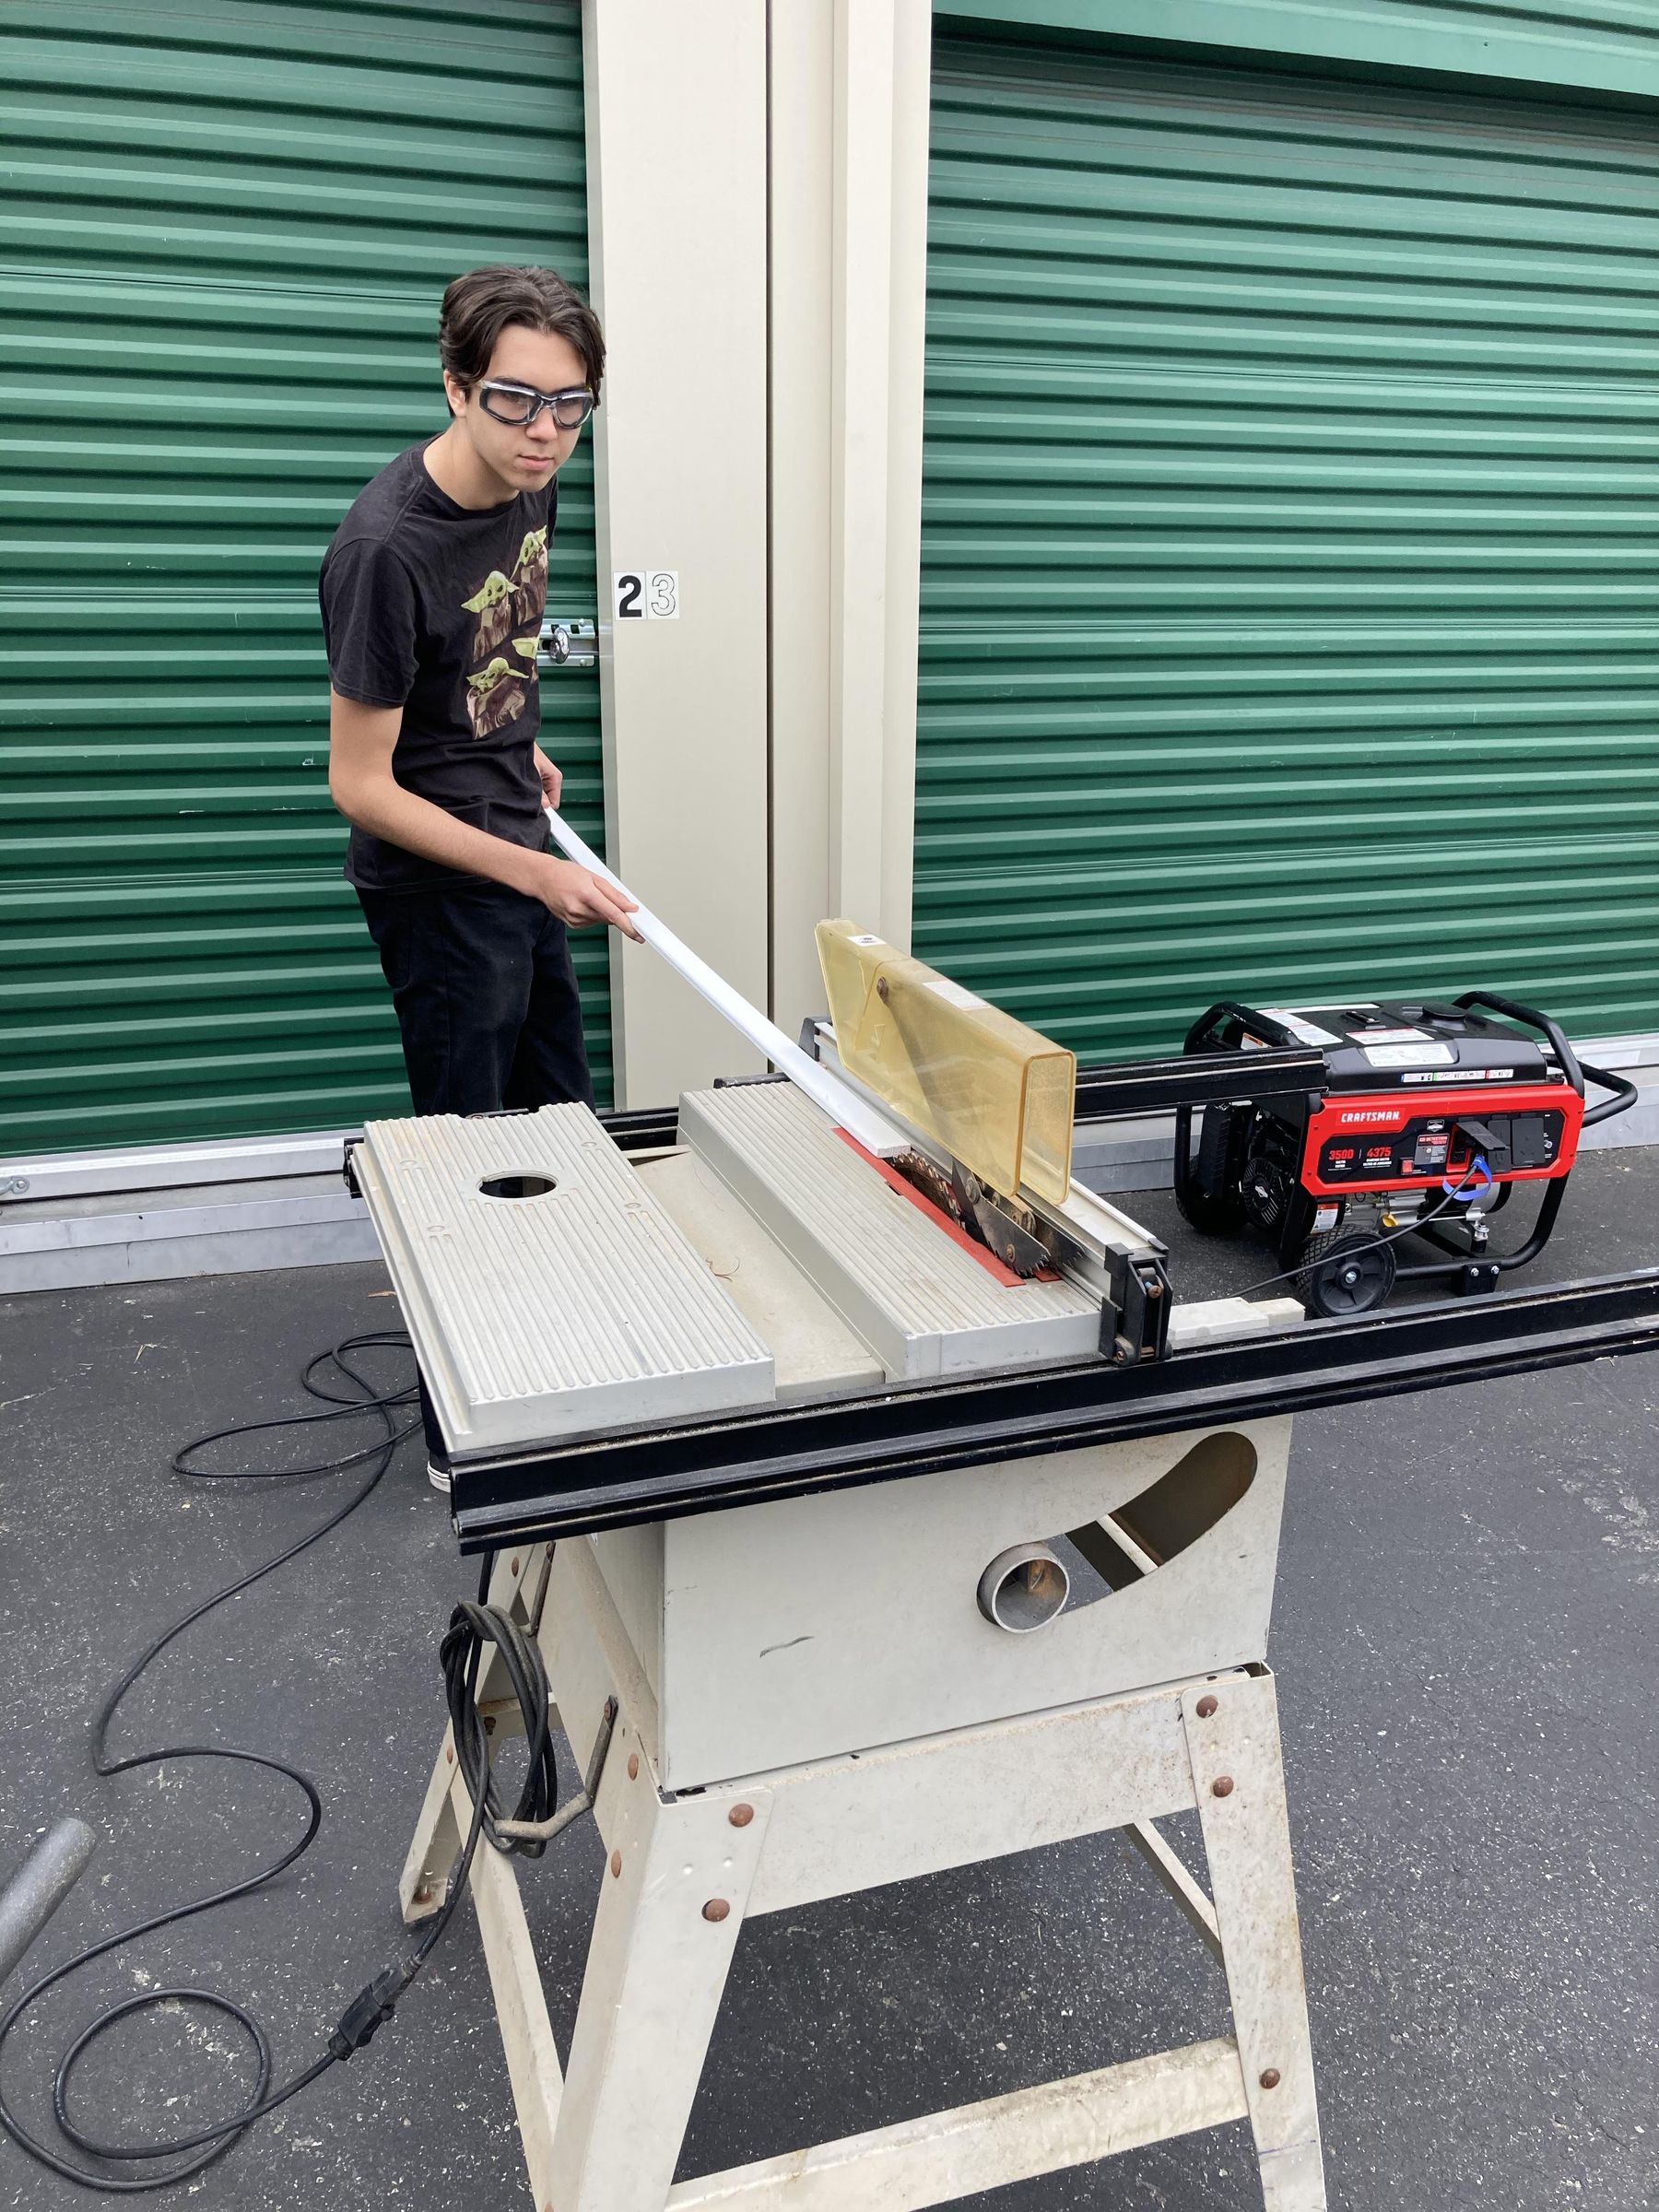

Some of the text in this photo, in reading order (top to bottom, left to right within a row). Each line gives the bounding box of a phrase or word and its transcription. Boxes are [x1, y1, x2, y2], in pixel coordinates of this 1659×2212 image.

[618, 573, 676, 618] 23
[1341, 1111, 1400, 1124] CRAFTSMAN
[1328, 1149, 1354, 1160] 3500
[1367, 1147, 1392, 1158] 4375
